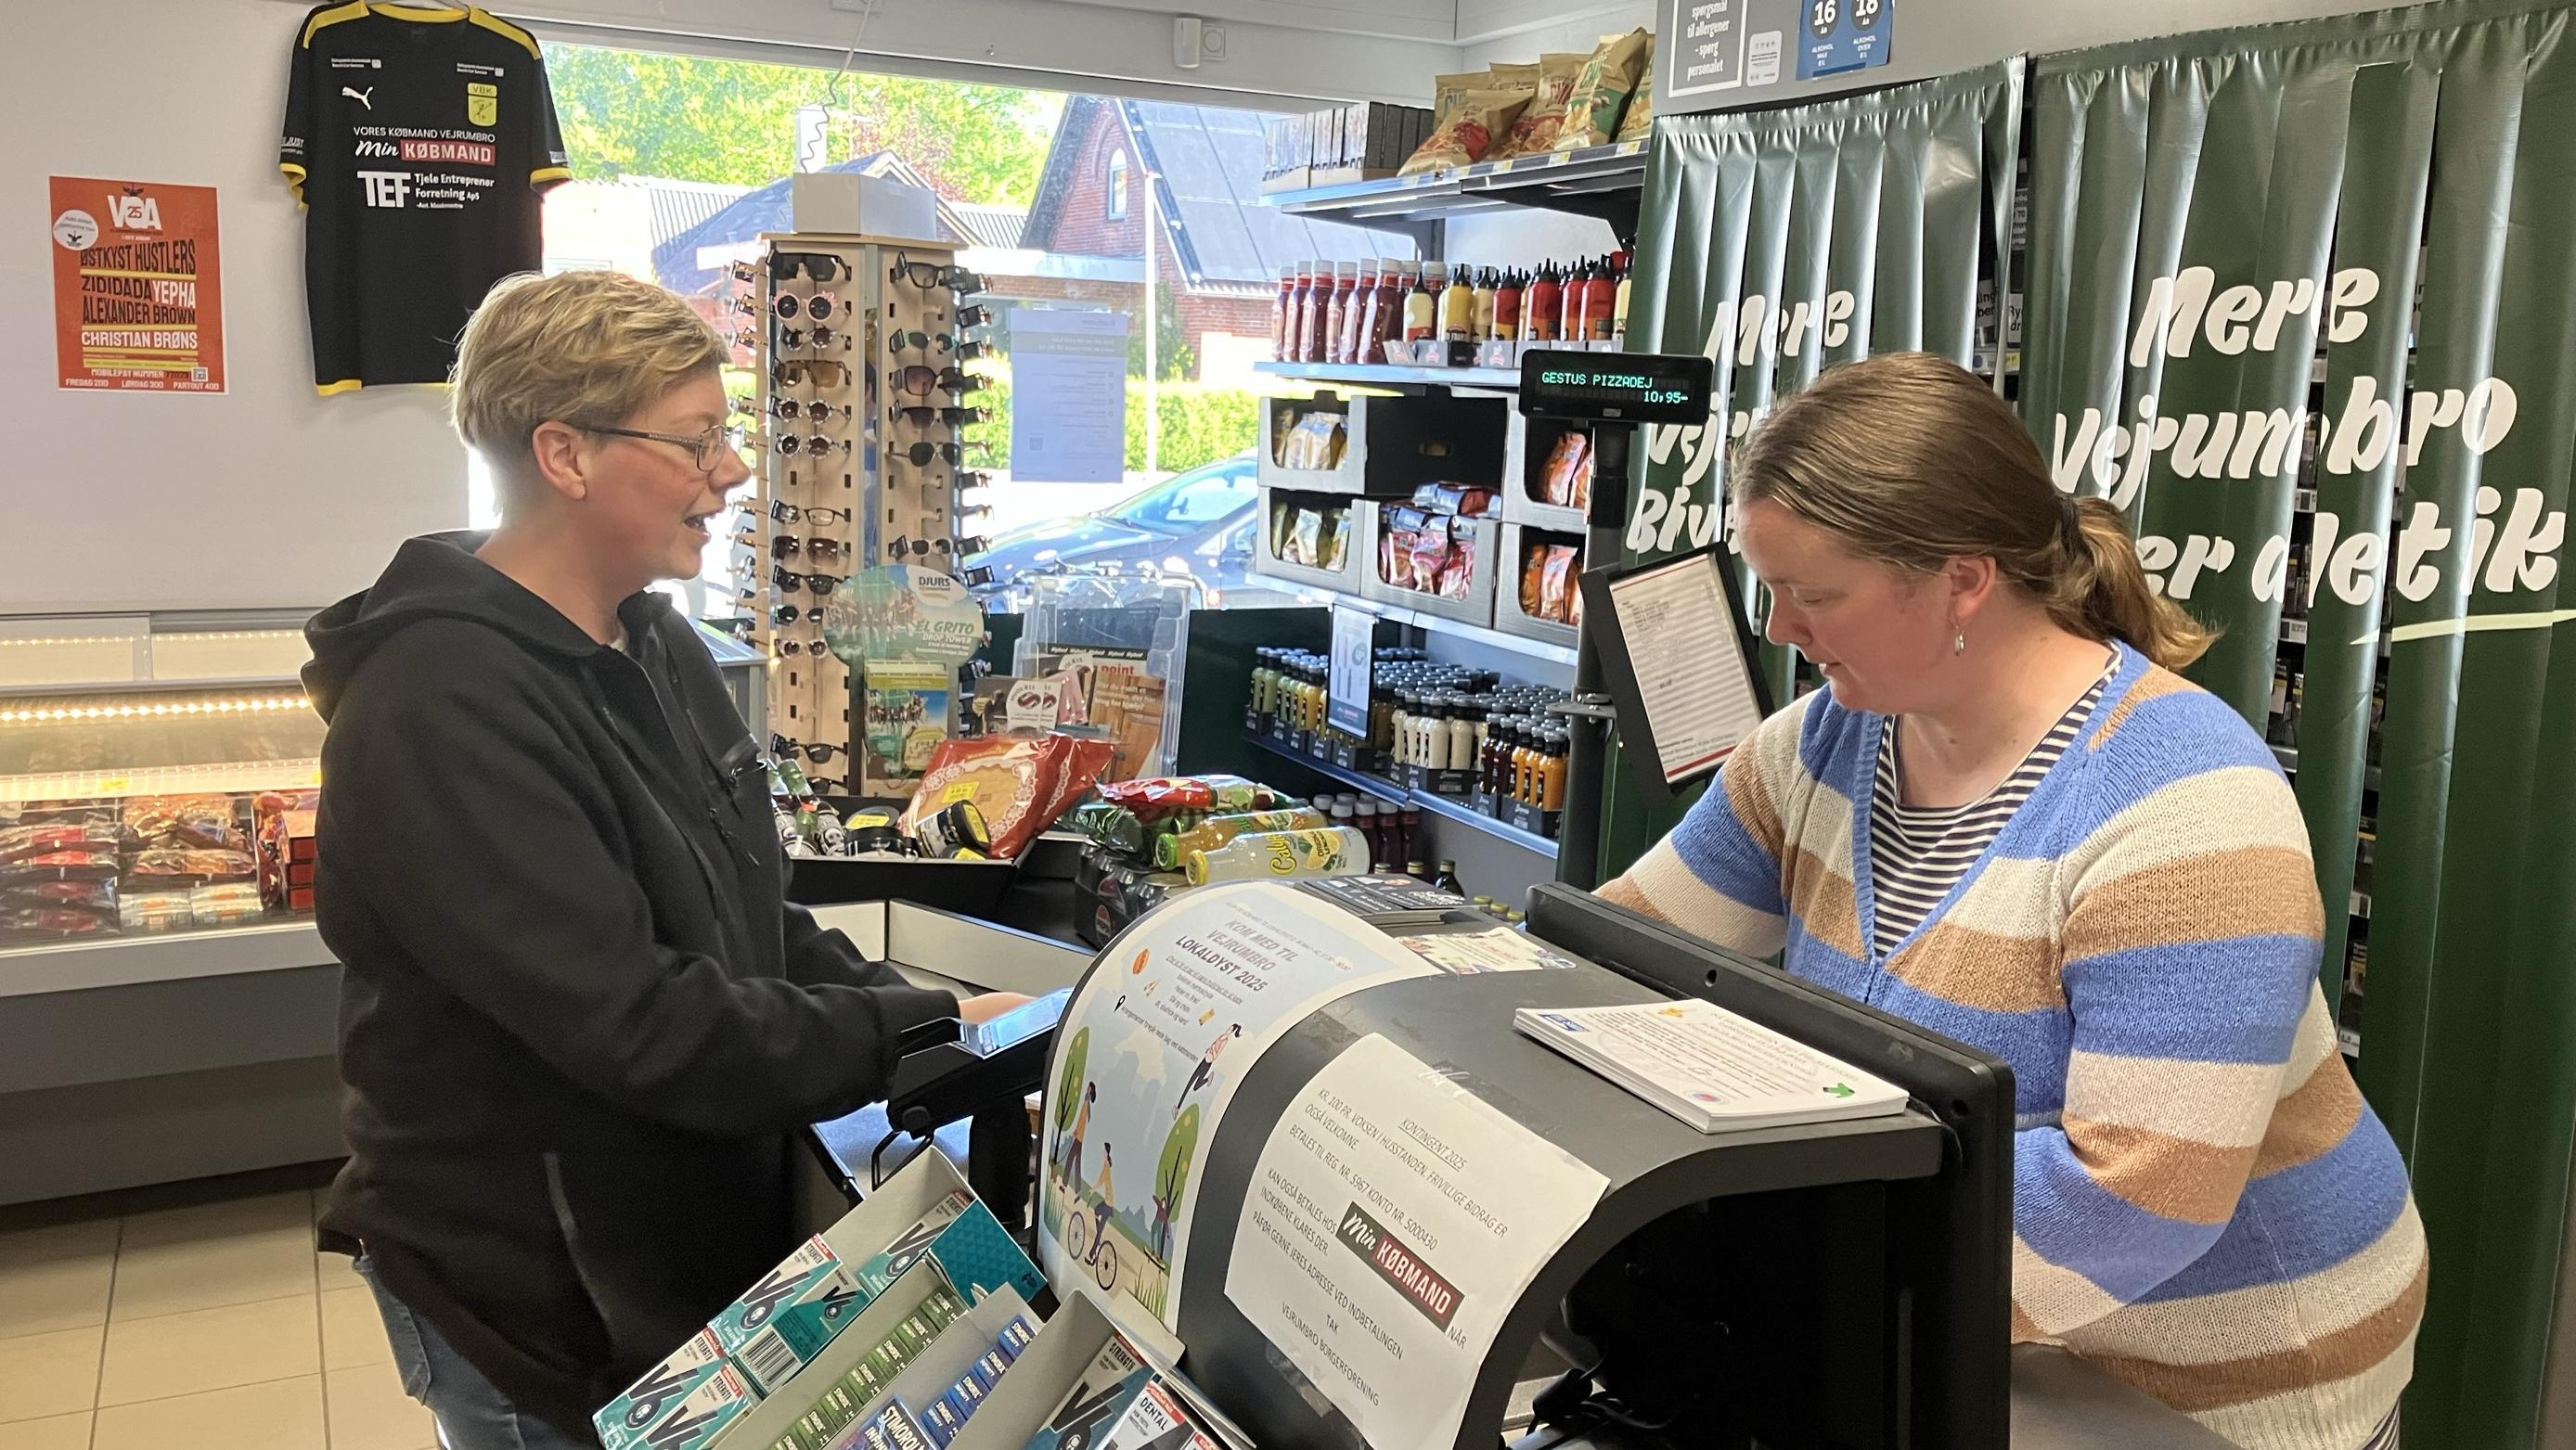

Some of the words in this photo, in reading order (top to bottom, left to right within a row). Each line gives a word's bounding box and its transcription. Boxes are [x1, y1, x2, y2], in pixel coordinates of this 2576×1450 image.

[1814, 0, 1836, 26] 16
[1856, 0, 1878, 17] 18
[1687, 22, 1695, 38] til
[1695, 20, 1730, 38] allergener
[1852, 34, 1876, 45] ALKOHOL
[1699, 41, 1719, 58] spørg
[1811, 44, 1834, 53] ALKOHOL
[1858, 44, 1872, 52] OVER
[1687, 58, 1724, 82] personalet
[472, 86, 493, 95] VBK
[354, 126, 386, 136] VORES
[388, 127, 438, 139] KØBMAND
[439, 130, 496, 143] VEJRUMBRO
[354, 140, 399, 158] Min
[405, 143, 492, 162] KØBMAND
[356, 171, 411, 208] TEF
[414, 173, 439, 186] Tjele
[415, 188, 466, 200] Forretning
[467, 192, 480, 200] ApS
[81, 244, 132, 270] ØSTKYST
[134, 238, 196, 276] HUSTLERS
[82, 275, 152, 302] ZIDIDADA
[152, 280, 196, 309] YEPHA
[84, 296, 150, 325] ALEXANDER
[154, 305, 196, 325] BROWN
[2130, 266, 2379, 368] Mere
[82, 331, 150, 348] CHRISTIAN
[154, 331, 199, 350] BRØNS
[1703, 290, 1855, 366] Mere
[66, 379, 93, 387] FREDAG
[149, 380, 164, 389] 300
[174, 381, 203, 390] PARTOUT
[204, 382, 220, 391] 400
[1541, 372, 1587, 385] GESTUS
[1592, 374, 1654, 389] PIZZADEJ
[2051, 376, 2518, 512] Vejrumbro
[2251, 502, 2452, 609] det
[919, 576, 951, 587] DJURS
[922, 633, 944, 642] DROP
[945, 634, 972, 645] TOWER
[934, 621, 974, 635] GRITO
[1206, 930, 1277, 971] VEJRUMBRO
[1225, 919, 1252, 939] KOM
[1252, 932, 1280, 951] MED
[1276, 947, 1299, 962] TIL
[1176, 935, 1242, 975] LOKALDYST
[1234, 970, 1269, 992] 2025
[1305, 1103, 1324, 1123] OGSÅ
[1322, 1111, 1359, 1151] VELKOMNE.
[1401, 1119, 1450, 1161] KONTINGENT
[1444, 1149, 1468, 1170] 2025
[1318, 1088, 1329, 1103] KR.
[1328, 1095, 1343, 1110] 100
[1339, 1103, 1353, 1120] PR.
[1351, 1112, 1380, 1138] VOKSEN
[1379, 1135, 1430, 1178] HUSSTANDEN.
[1426, 1171, 1468, 1206] FRIVILLIGE
[1463, 1198, 1499, 1229] BIDRAG
[1494, 1221, 1510, 1238] ER
[1289, 1123, 1320, 1151] BETALES
[1313, 1142, 1325, 1158] TIL
[1322, 1151, 1339, 1172] REG.
[1338, 1164, 1351, 1181] NR.
[1349, 1174, 1370, 1194] 5967
[1366, 1186, 1394, 1213] KONTO
[1390, 1208, 1406, 1225] NR.
[1404, 1218, 1437, 1251] 5000430
[1260, 1187, 1294, 1221] INDKØBENE
[1292, 1211, 1317, 1241] KLARES
[1313, 1235, 1329, 1256] DER.
[1268, 1167, 1282, 1185] KAN
[1280, 1179, 1300, 1200] OGSÅ
[1296, 1193, 1324, 1221] BETALES
[1321, 1214, 1337, 1235] HOS
[1343, 1212, 1377, 1251] Min
[1375, 1240, 1452, 1314] KØBMAND
[1447, 1327, 1467, 1350] NÅR
[1253, 1210, 1271, 1236] PÅFØR
[1270, 1229, 1292, 1252] GERNE
[1288, 1245, 1308, 1268] JERES
[1306, 1260, 1334, 1295] ADRESSE
[1333, 1288, 1349, 1309] VED
[1347, 1302, 1404, 1361] INDBETALINGEN
[741, 1270, 812, 1331] V6
[821, 1285, 857, 1320] V6
[1325, 1314, 1341, 1336] TAK
[694, 1336, 714, 1361] STRENGTH
[1108, 1342, 1137, 1373] STRENGTH
[1282, 1302, 1320, 1346] VEJRUMBRO
[1319, 1339, 1380, 1406] BORGERFORENING
[624, 1363, 700, 1430] V6
[713, 1375, 732, 1402] STRENGTH
[1140, 1396, 1170, 1431] DENTAL
